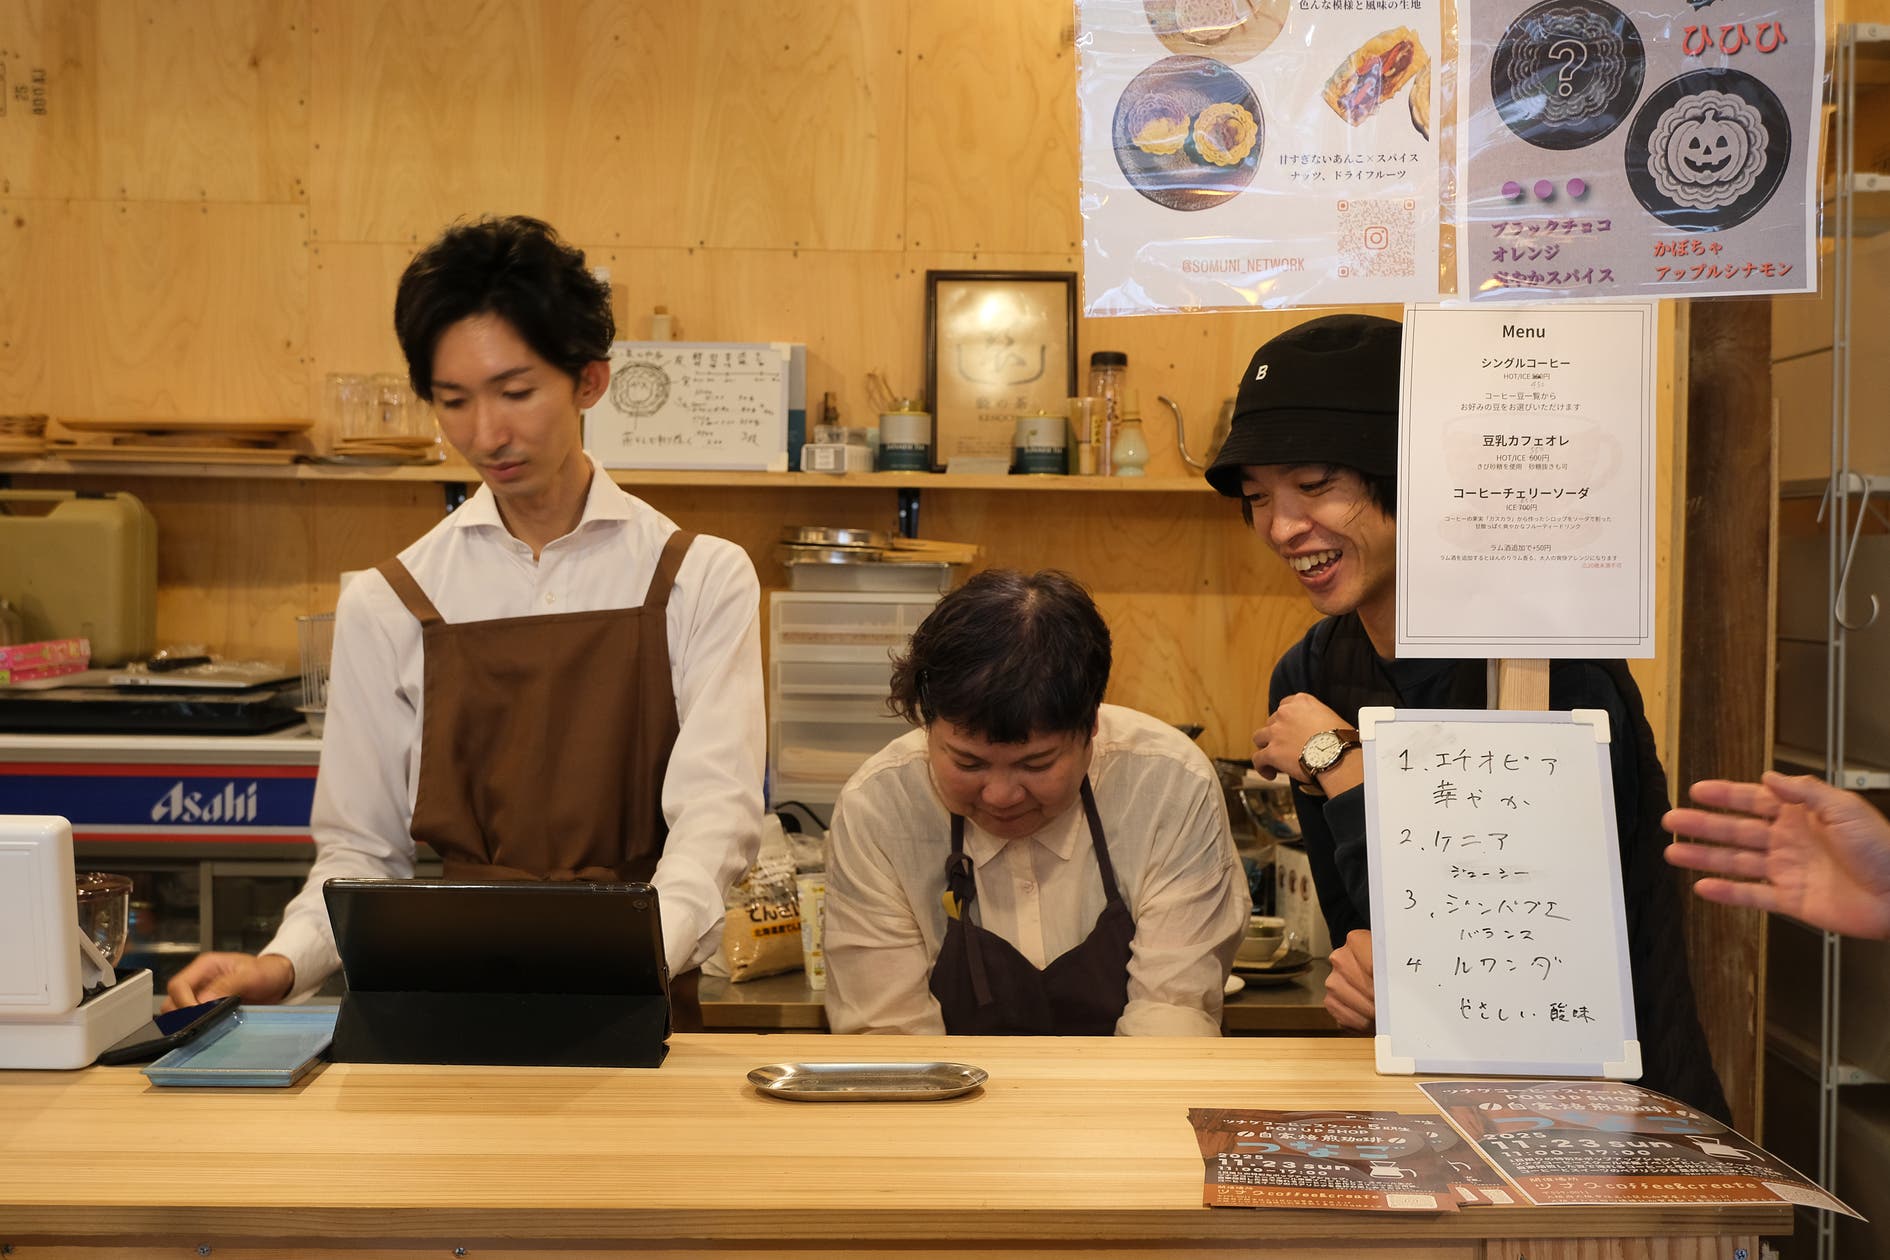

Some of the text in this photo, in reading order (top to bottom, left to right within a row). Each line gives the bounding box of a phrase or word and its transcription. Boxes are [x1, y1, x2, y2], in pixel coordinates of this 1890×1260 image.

[1682, 21, 1788, 57] ひひひ
[1290, 169, 1407, 182] ナッツ、ドライフルーツ
[1491, 243, 1561, 263] オレンジ
[1653, 240, 1723, 257] かぼちゃ
[1654, 262, 1793, 282] アップルシナモン
[1502, 325, 1546, 338] Menu
[1481, 357, 1571, 369] シングルコーヒー
[1255, 364, 1269, 381] B
[1485, 392, 1557, 400] コーヒー豆一覧から
[1460, 403, 1581, 412] お好みの豆をお選びいただけます
[1483, 435, 1570, 447] 豆乳カフェオレ
[1496, 454, 1526, 462] HOT/ICE
[1453, 487, 1590, 500] コーヒーチェリーソーダ
[1433, 780, 1531, 809] 華やか
[151, 781, 258, 823] Asahi
[1435, 831, 1509, 852] ケニア
[1460, 927, 1535, 941] バランス
[1454, 956, 1562, 981] ルワンダ
[1460, 998, 1597, 1023] やさしい 酸味
[1483, 1131, 1547, 1141] 2025
[1491, 1137, 1673, 1151] 11.23 sun
[1217, 1152, 1264, 1160] 2025
[1217, 1159, 1351, 1172] 11.23 sun
